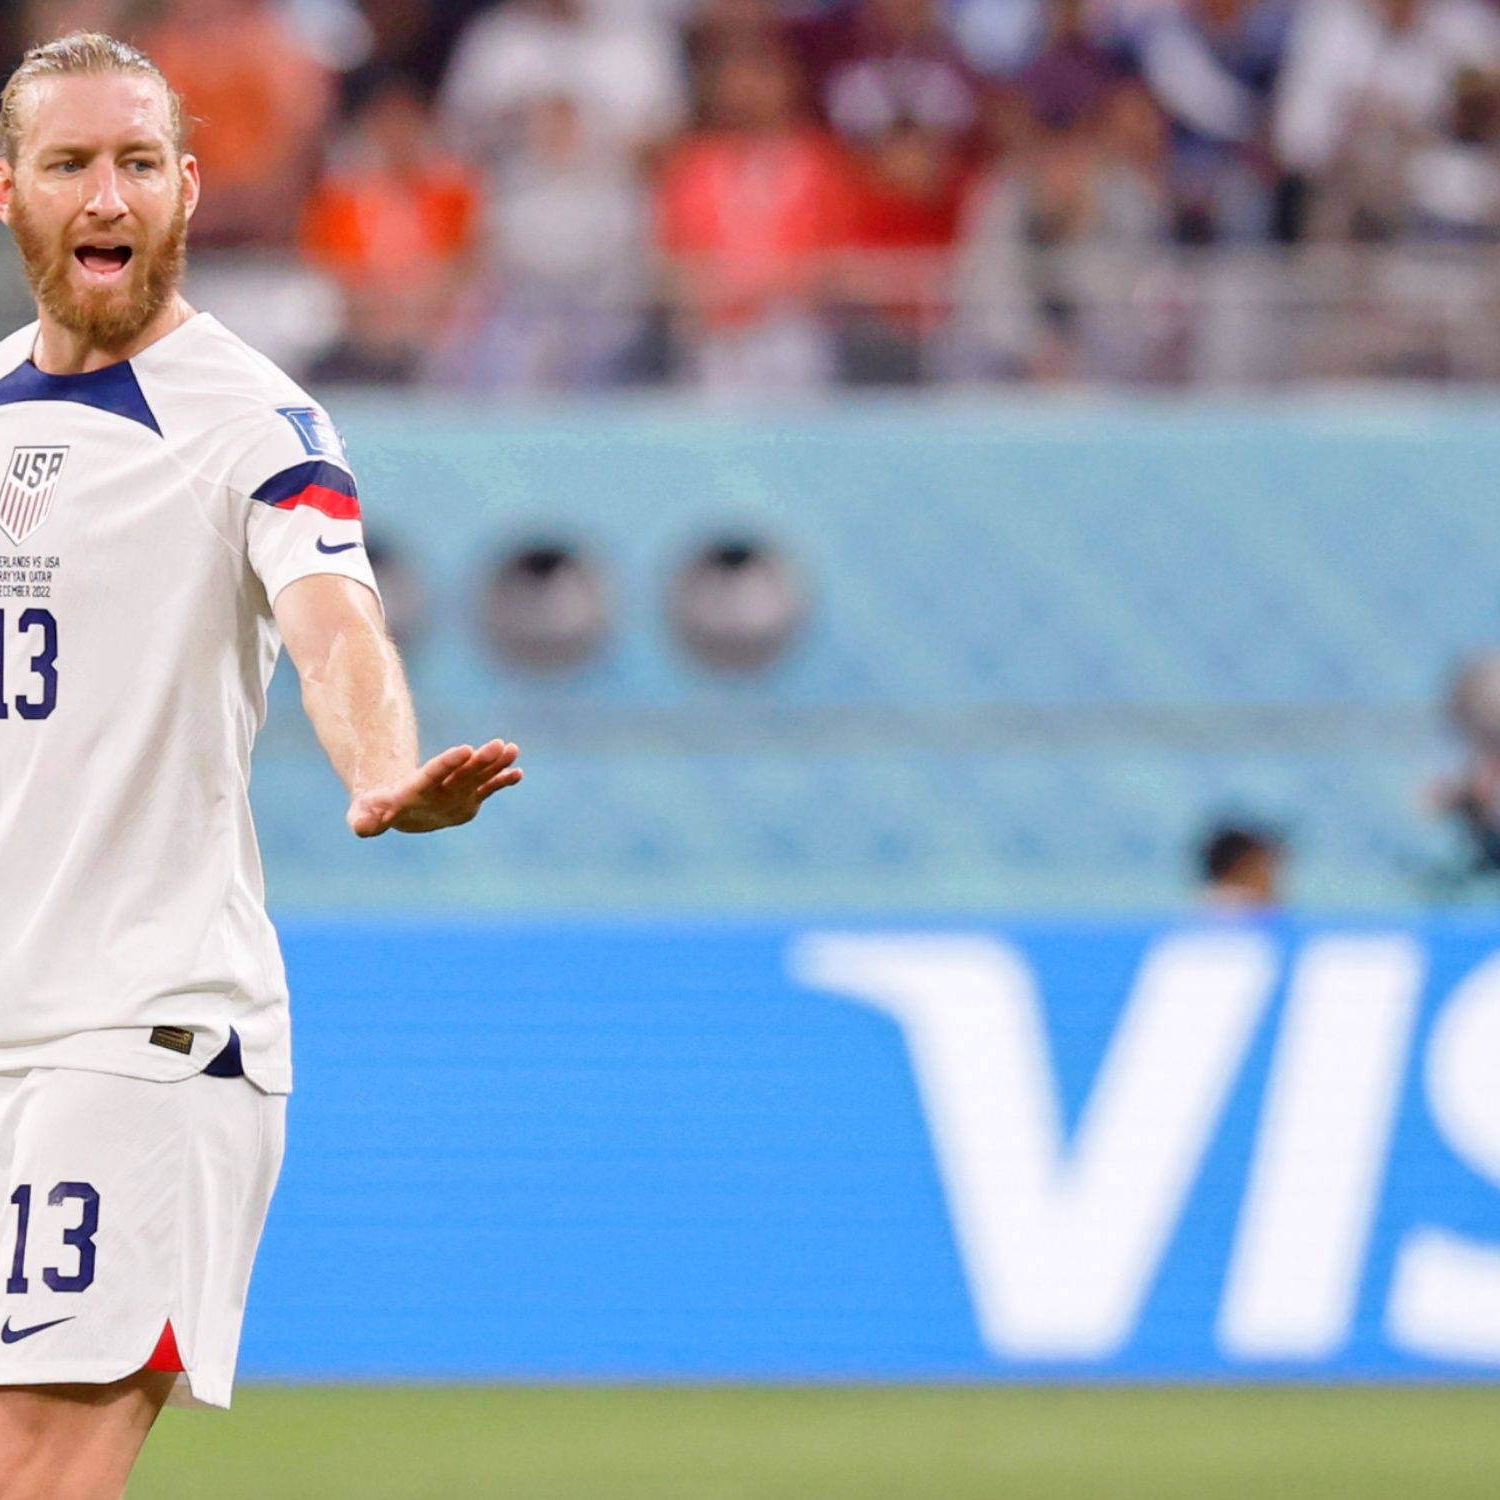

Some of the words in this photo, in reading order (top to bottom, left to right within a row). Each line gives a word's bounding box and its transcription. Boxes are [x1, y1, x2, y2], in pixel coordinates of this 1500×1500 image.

[12, 453, 63, 488] USA
[33, 556, 42, 568] VS
[45, 556, 60, 568] USA
[29, 571, 52, 582] QATAR
[32, 585, 51, 597] 2022
[6, 1181, 100, 1294] 13
